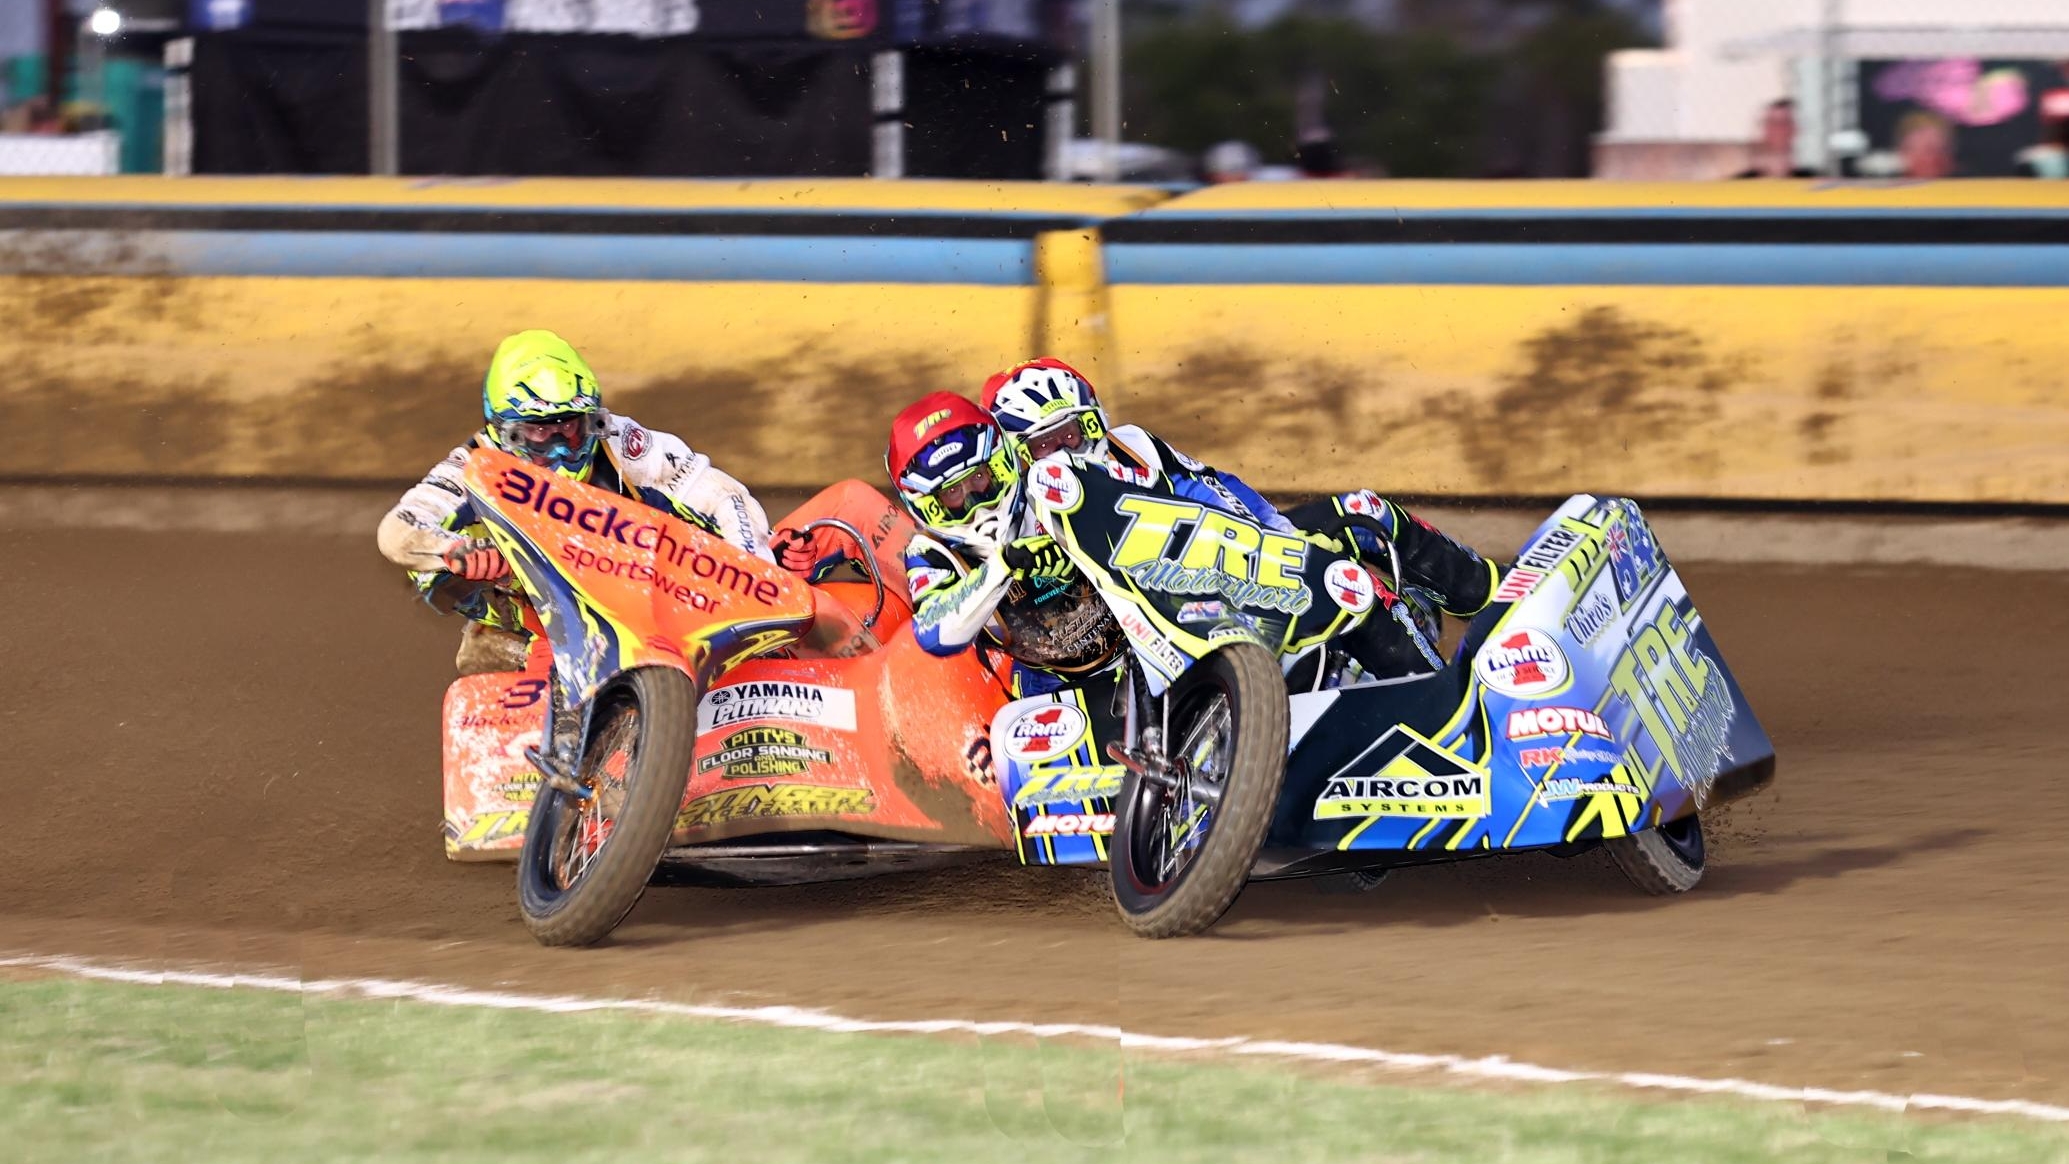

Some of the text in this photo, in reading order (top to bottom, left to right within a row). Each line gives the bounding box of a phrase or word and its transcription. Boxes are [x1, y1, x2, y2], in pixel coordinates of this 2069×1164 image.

[1109, 493, 1309, 590] TRE
[561, 543, 721, 615] sportswear
[1496, 527, 1580, 601] UNI FILTER
[1127, 558, 1312, 616] Motorsport
[1049, 603, 1099, 641] AUSTRA
[1062, 608, 1107, 646] SPEED
[1066, 610, 1114, 653] CENTENAR
[1565, 592, 1616, 649] Chiro's
[1121, 613, 1185, 673] UNI FILTER
[734, 683, 823, 702] YAMAHA
[1608, 594, 1711, 790] TRE
[731, 728, 796, 747] PITTYS
[1507, 706, 1614, 741] MOTUL
[702, 745, 827, 769] FLOOR SANDING
[731, 760, 801, 775] POLISHING
[1520, 747, 1564, 768] RK
[1014, 765, 1128, 802] TRE
[1323, 777, 1482, 800] AIRCOM
[1024, 814, 1118, 836] MOTU
[1341, 802, 1465, 813] SYSTEMS
